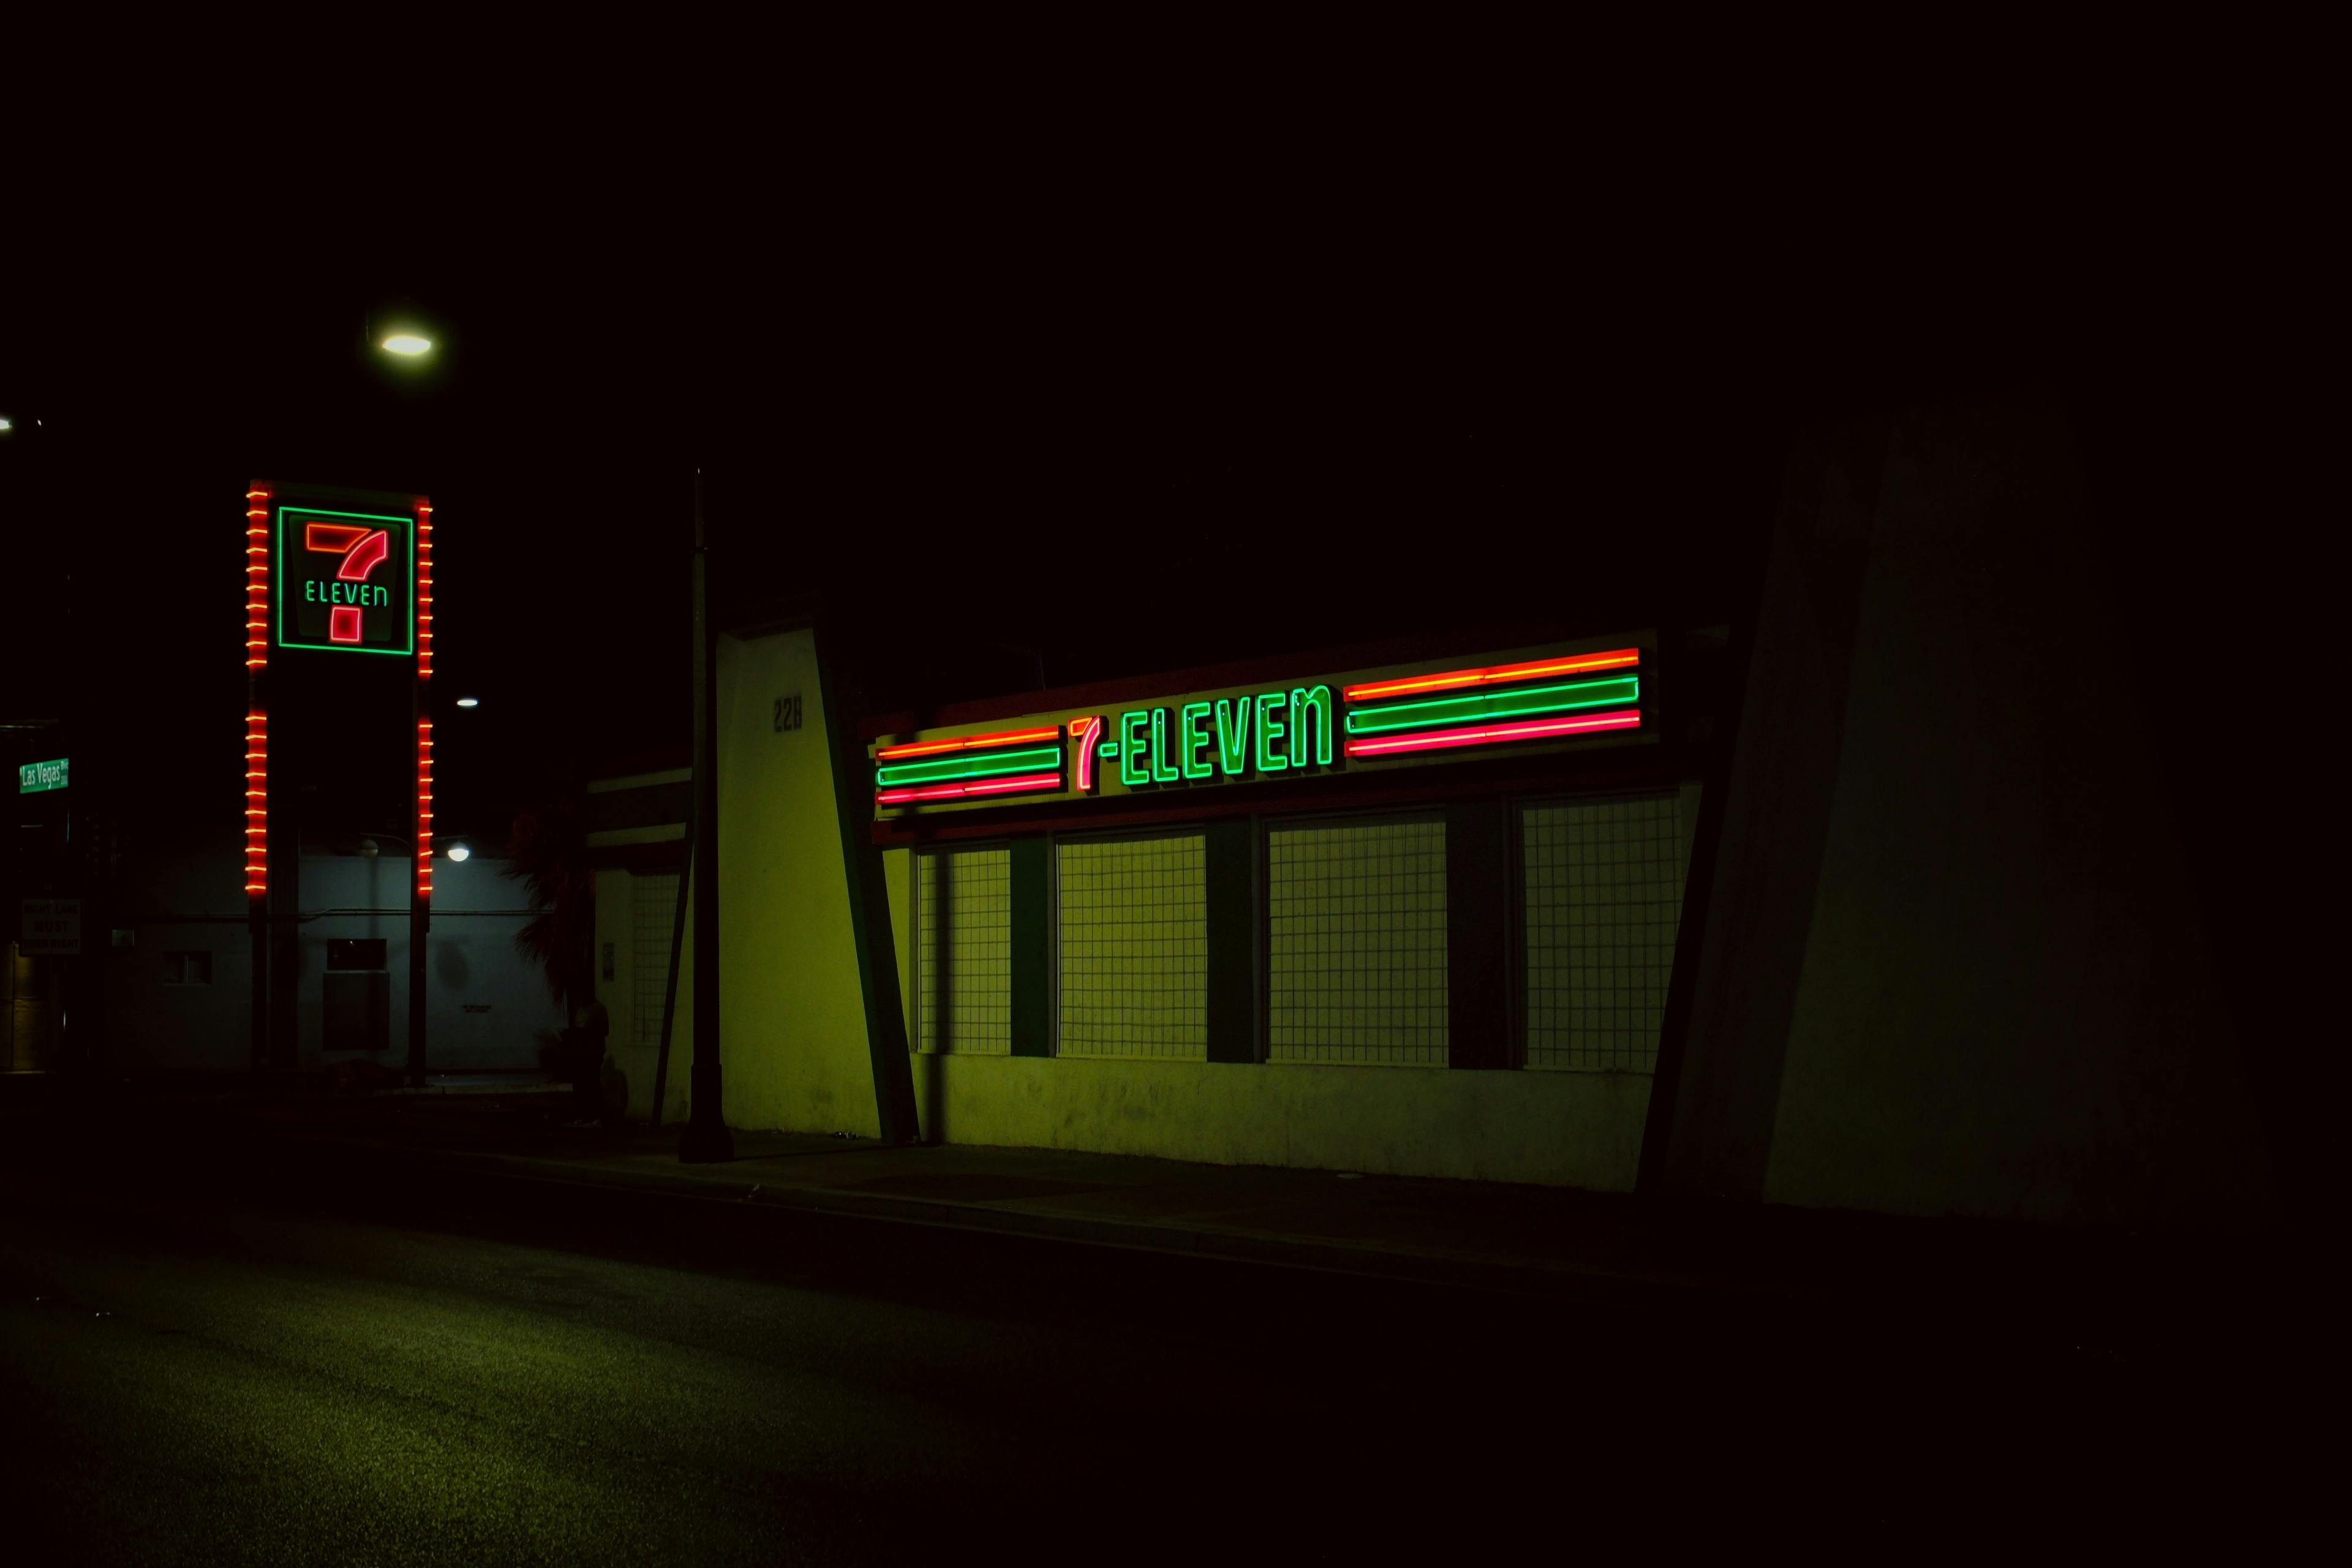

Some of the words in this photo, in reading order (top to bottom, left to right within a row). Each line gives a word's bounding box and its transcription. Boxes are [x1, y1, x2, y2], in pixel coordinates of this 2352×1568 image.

[306, 522, 388, 641] 7
[22, 765, 36, 786] Las
[37, 763, 60, 790] Vegas
[34, 920, 68, 932] MUST
